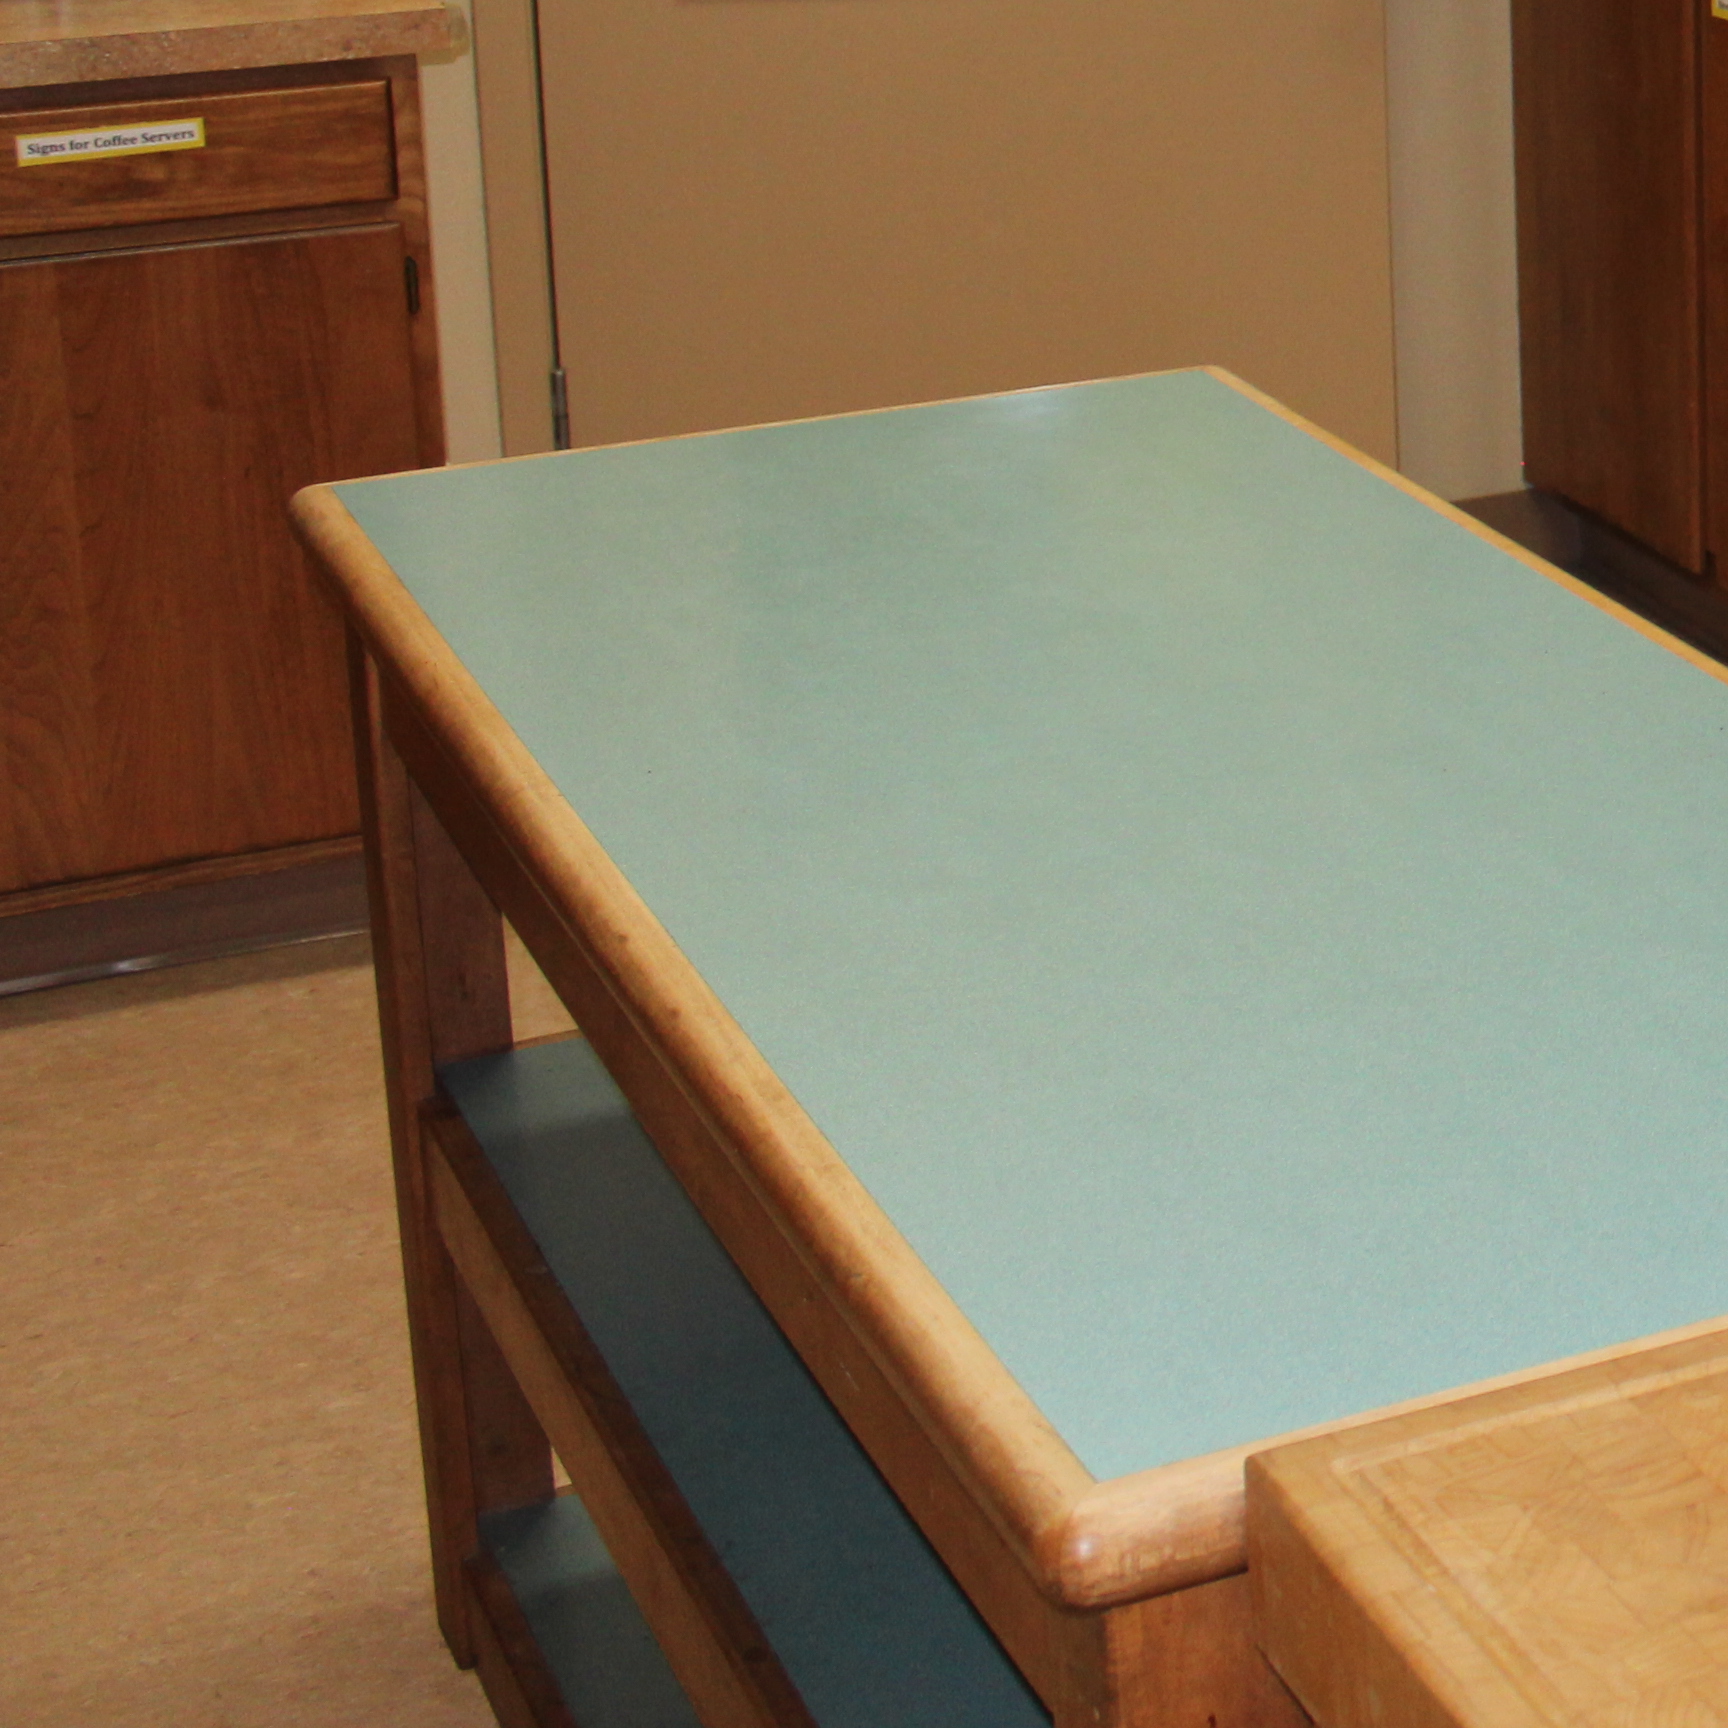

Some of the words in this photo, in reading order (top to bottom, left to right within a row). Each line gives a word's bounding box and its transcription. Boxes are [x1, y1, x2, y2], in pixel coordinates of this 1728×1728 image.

[27, 142, 66, 155] Signs
[69, 139, 90, 151] for
[94, 135, 138, 148] Coffee
[141, 129, 196, 144] Servers
